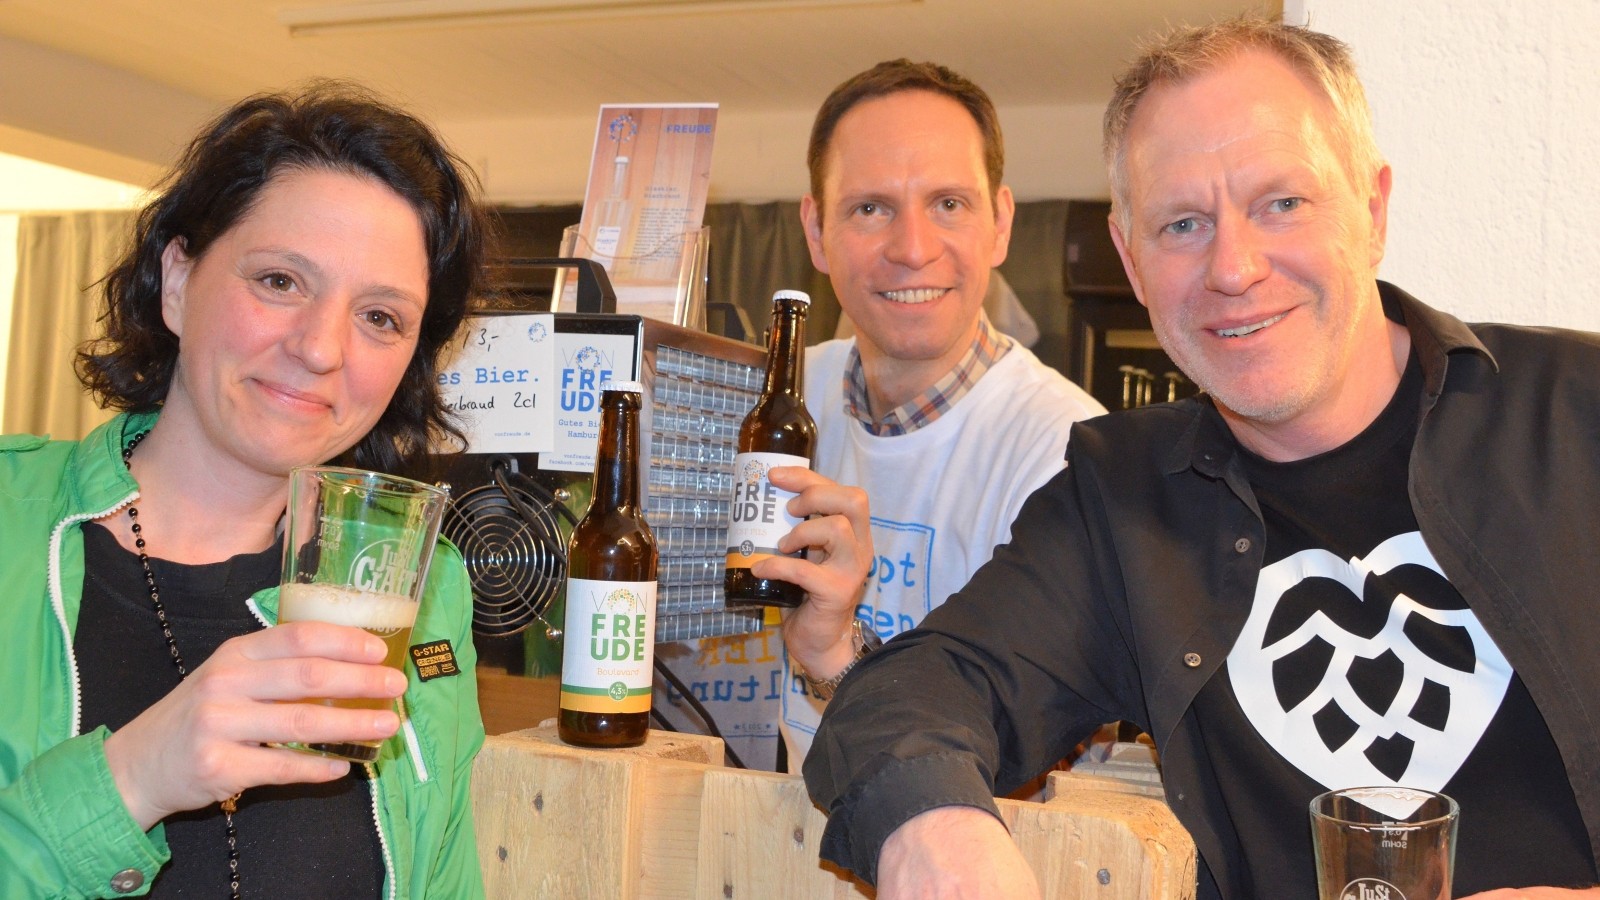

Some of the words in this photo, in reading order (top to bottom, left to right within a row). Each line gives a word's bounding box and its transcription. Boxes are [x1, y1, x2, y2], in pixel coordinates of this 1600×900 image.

[665, 123, 712, 134] FREUDE
[475, 366, 539, 384] Bier.
[561, 391, 602, 412] UD
[558, 418, 584, 427] Gutes
[588, 420, 601, 428] Bi
[734, 481, 777, 503] FRE
[733, 502, 776, 524] UDE
[591, 613, 646, 638] FRE
[413, 643, 450, 658] G-STAR
[590, 638, 645, 662] UDE
